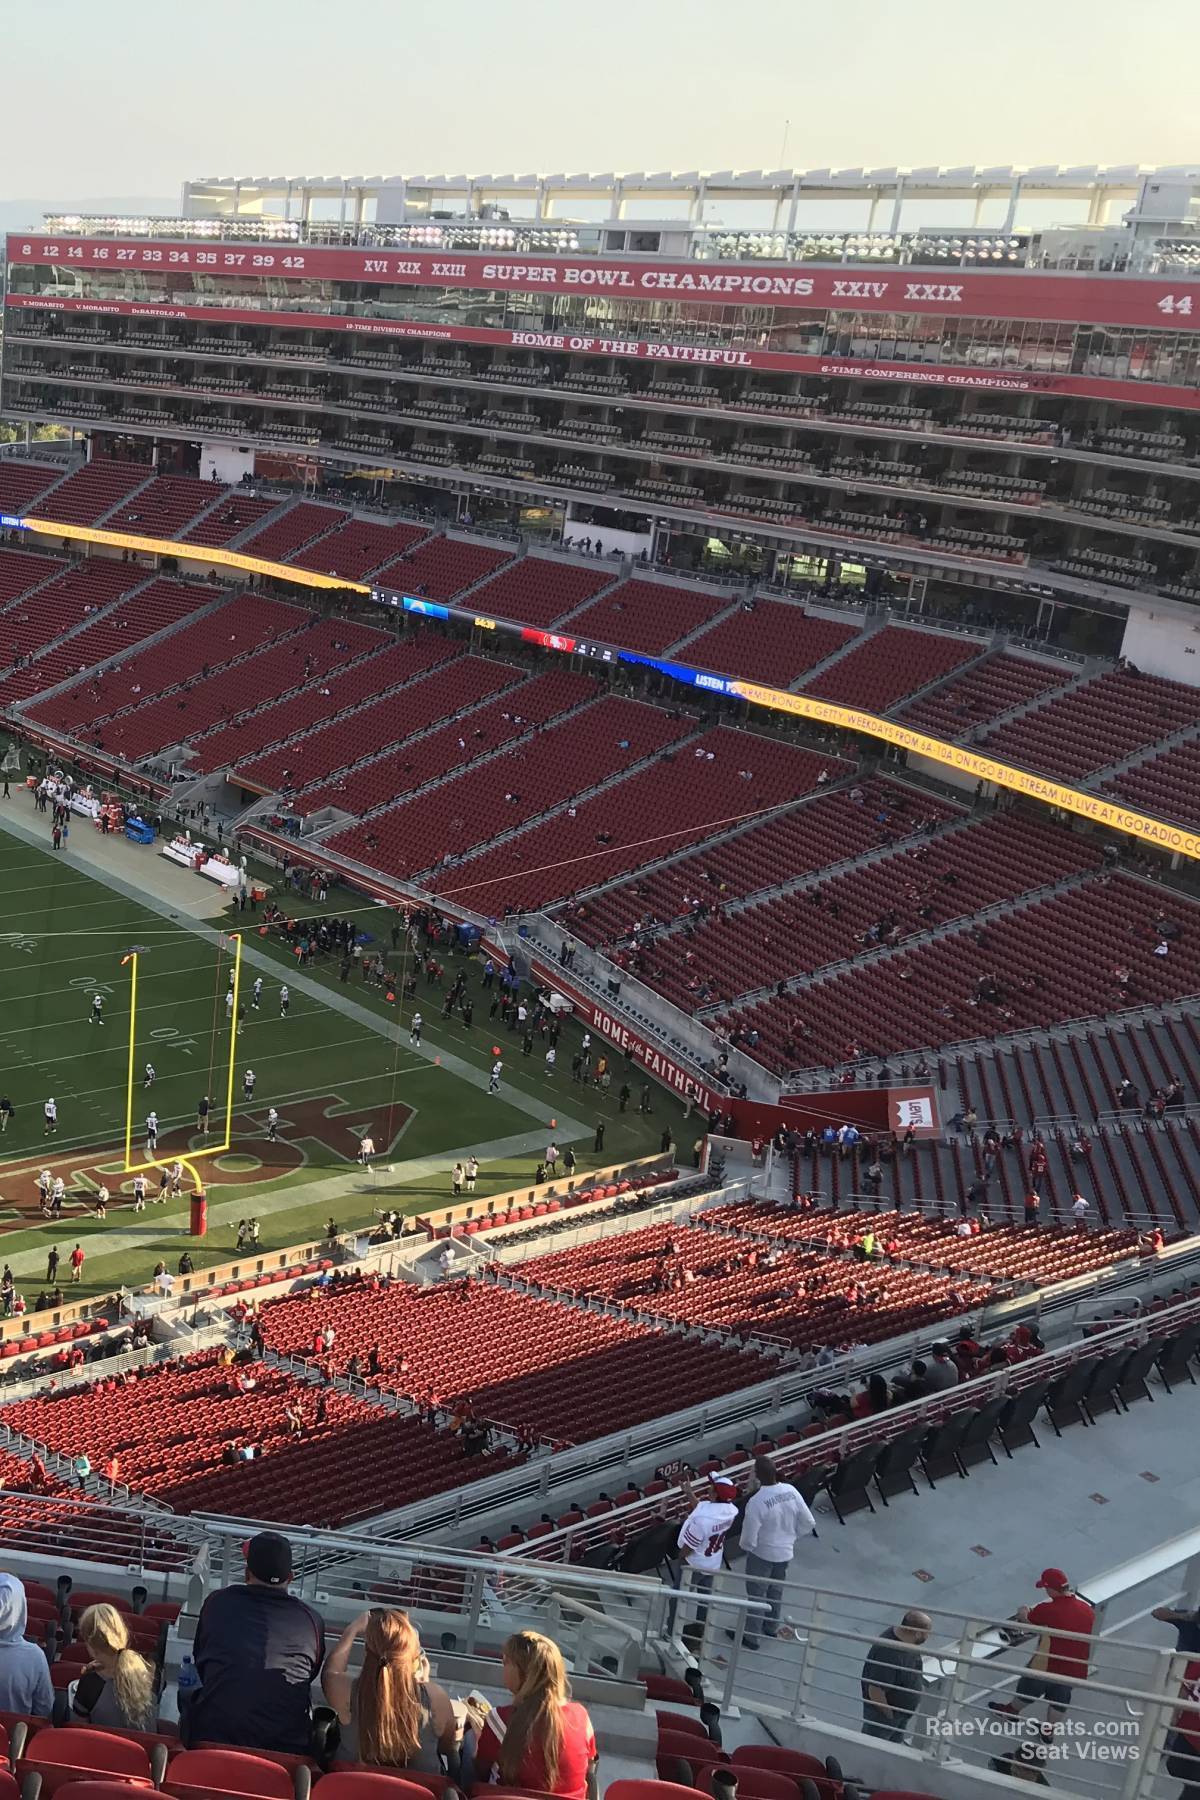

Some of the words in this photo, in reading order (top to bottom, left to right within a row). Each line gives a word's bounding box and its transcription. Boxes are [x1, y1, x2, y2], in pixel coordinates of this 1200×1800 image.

[22, 244, 32, 255] 8
[42, 245, 59, 257] 12
[67, 246, 83, 258] 14
[92, 247, 109, 259] 16
[116, 249, 137, 260] 27
[142, 250, 162, 262] 33
[168, 251, 190, 263] 34
[196, 252, 217, 264] 35
[224, 253, 246, 265] 37
[252, 254, 274, 267] 39
[281, 256, 305, 268] 42
[364, 260, 388, 273] XVI
[397, 261, 422, 275] XIX
[431, 263, 467, 277] XXIII
[482, 264, 557, 283] SUPER
[563, 268, 635, 287] BOWL
[640, 271, 814, 295] CHAMPIONS
[831, 280, 888, 298] XXIV
[904, 283, 964, 302] XXIX
[1156, 294, 1193, 315] 44
[372, 325, 406, 335] DIVISION
[407, 328, 451, 338] CHAMPIONS
[511, 331, 564, 348] HOME
[569, 336, 595, 350] OF
[600, 339, 639, 355] THE
[645, 342, 752, 365] FAITHFUL
[821, 364, 862, 375] 6-TIME
[864, 368, 945, 383] CONFERENCE
[947, 374, 1029, 389] CHAMPIONS
[696, 674, 724, 691] LISTEN
[741, 685, 801, 711] ARMSTRONG
[814, 705, 844, 722] GETTY
[847, 713, 895, 740] WEEKDAYS
[895, 730, 919, 748] FROM
[921, 742, 953, 761] 6A-10A
[955, 754, 971, 768] ON
[972, 760, 996, 778] KGO
[1019, 778, 1059, 800] STREAM
[1060, 793, 1074, 806] US
[1076, 796, 1099, 816] LIVE
[1100, 806, 1115, 821] AT
[593, 1009, 629, 1049] HOME
